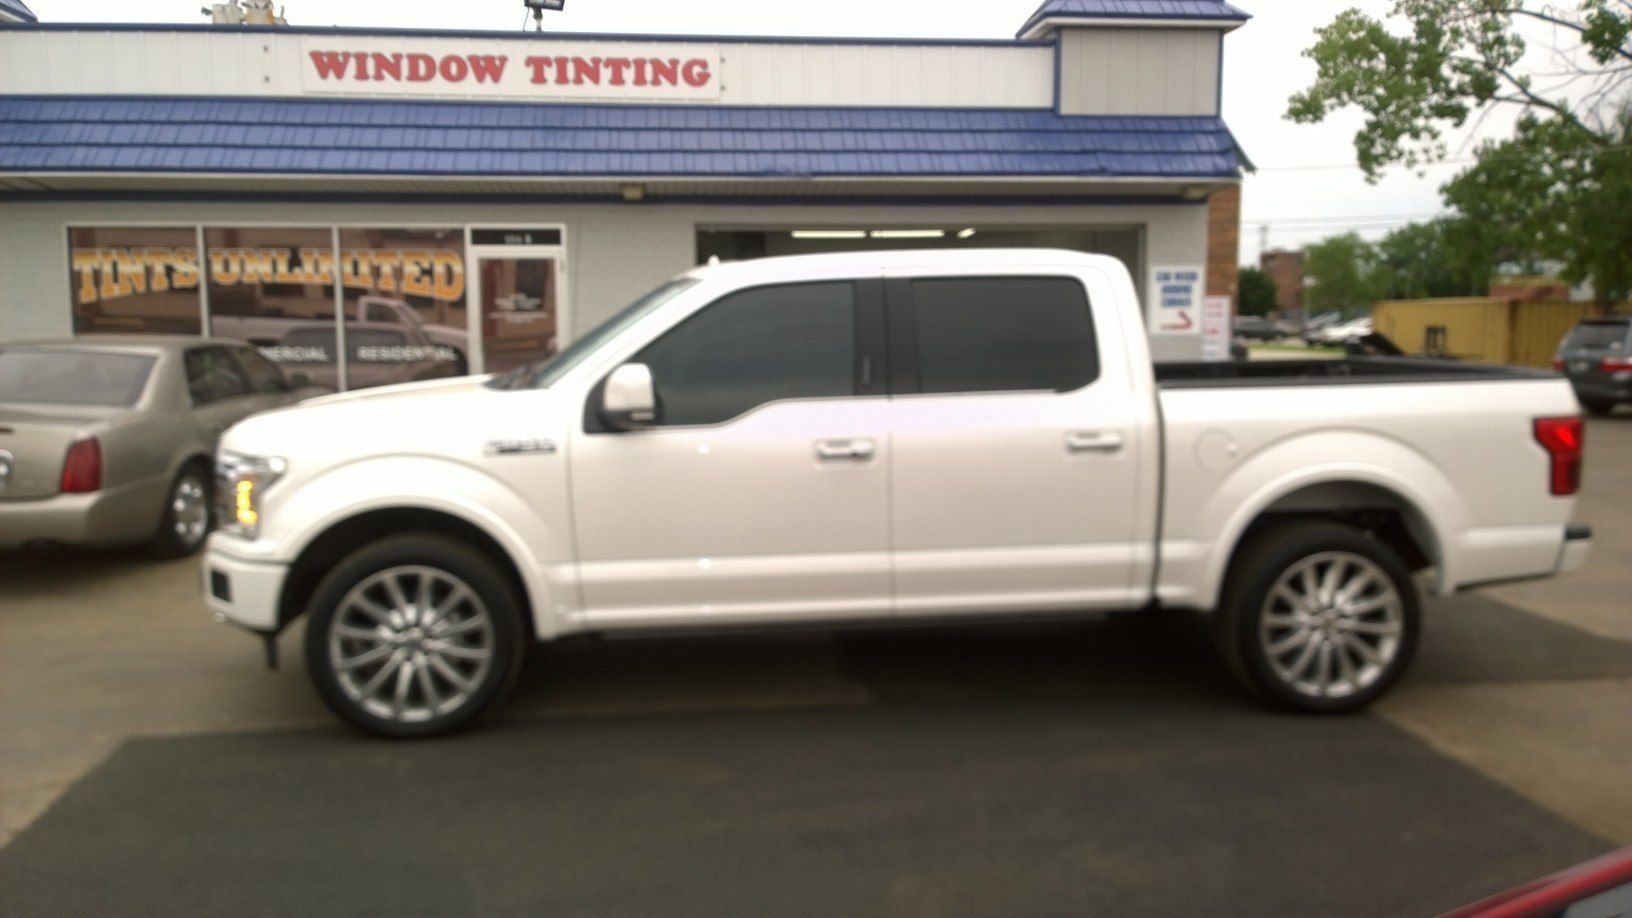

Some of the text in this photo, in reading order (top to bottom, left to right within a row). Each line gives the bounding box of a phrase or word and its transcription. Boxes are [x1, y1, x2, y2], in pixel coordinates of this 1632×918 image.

[308, 50, 712, 88] WINDOW TINTING
[72, 247, 465, 303] TINTS UNLIMITED
